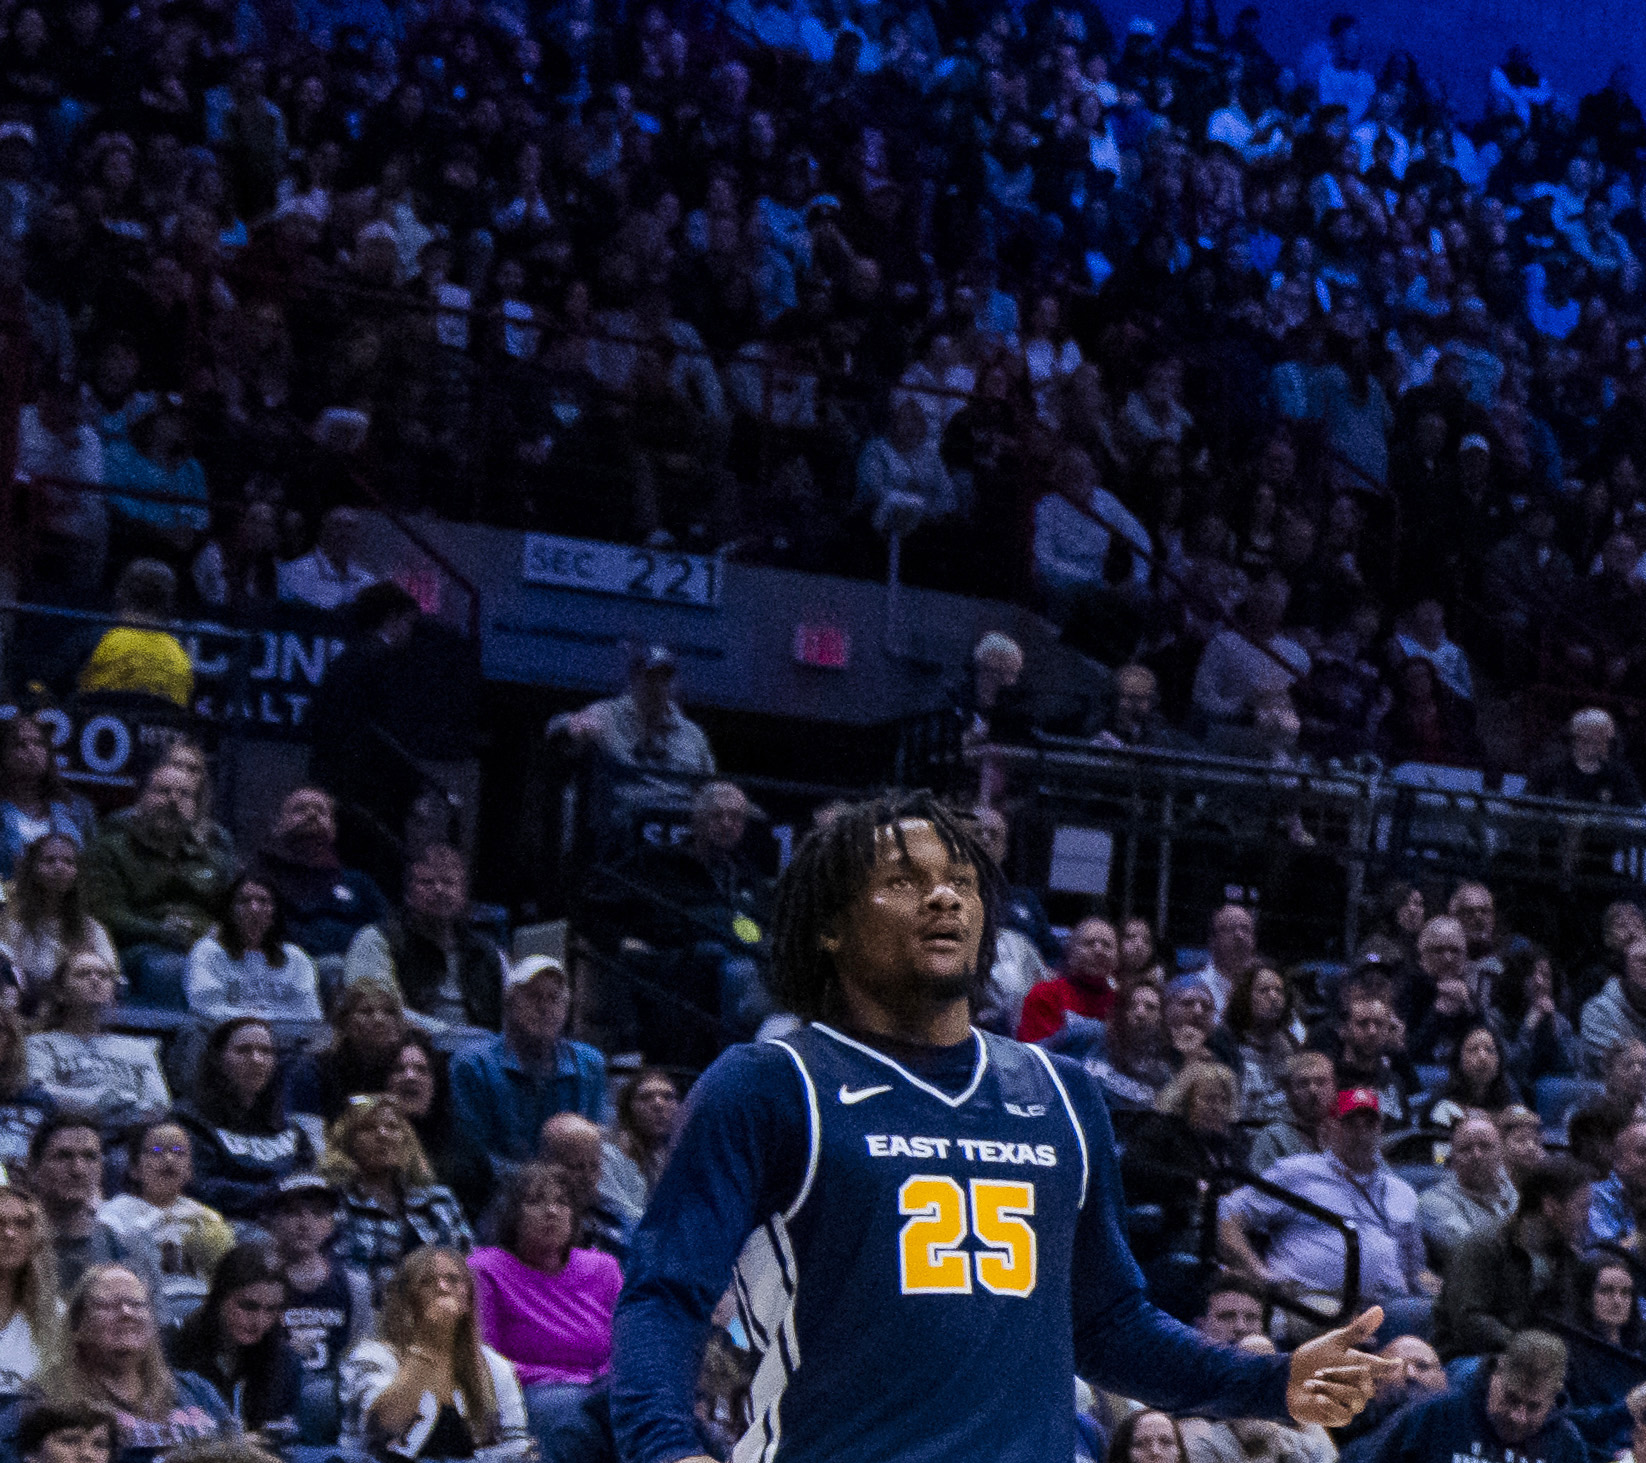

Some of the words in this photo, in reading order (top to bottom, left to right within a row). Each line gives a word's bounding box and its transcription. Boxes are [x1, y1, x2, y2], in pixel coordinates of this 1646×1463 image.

[529, 544, 596, 581] SEC
[627, 553, 717, 600] 221
[865, 1133, 950, 1160] EAST
[956, 1138, 1058, 1170] TEXAS
[898, 1175, 1039, 1300] 25
